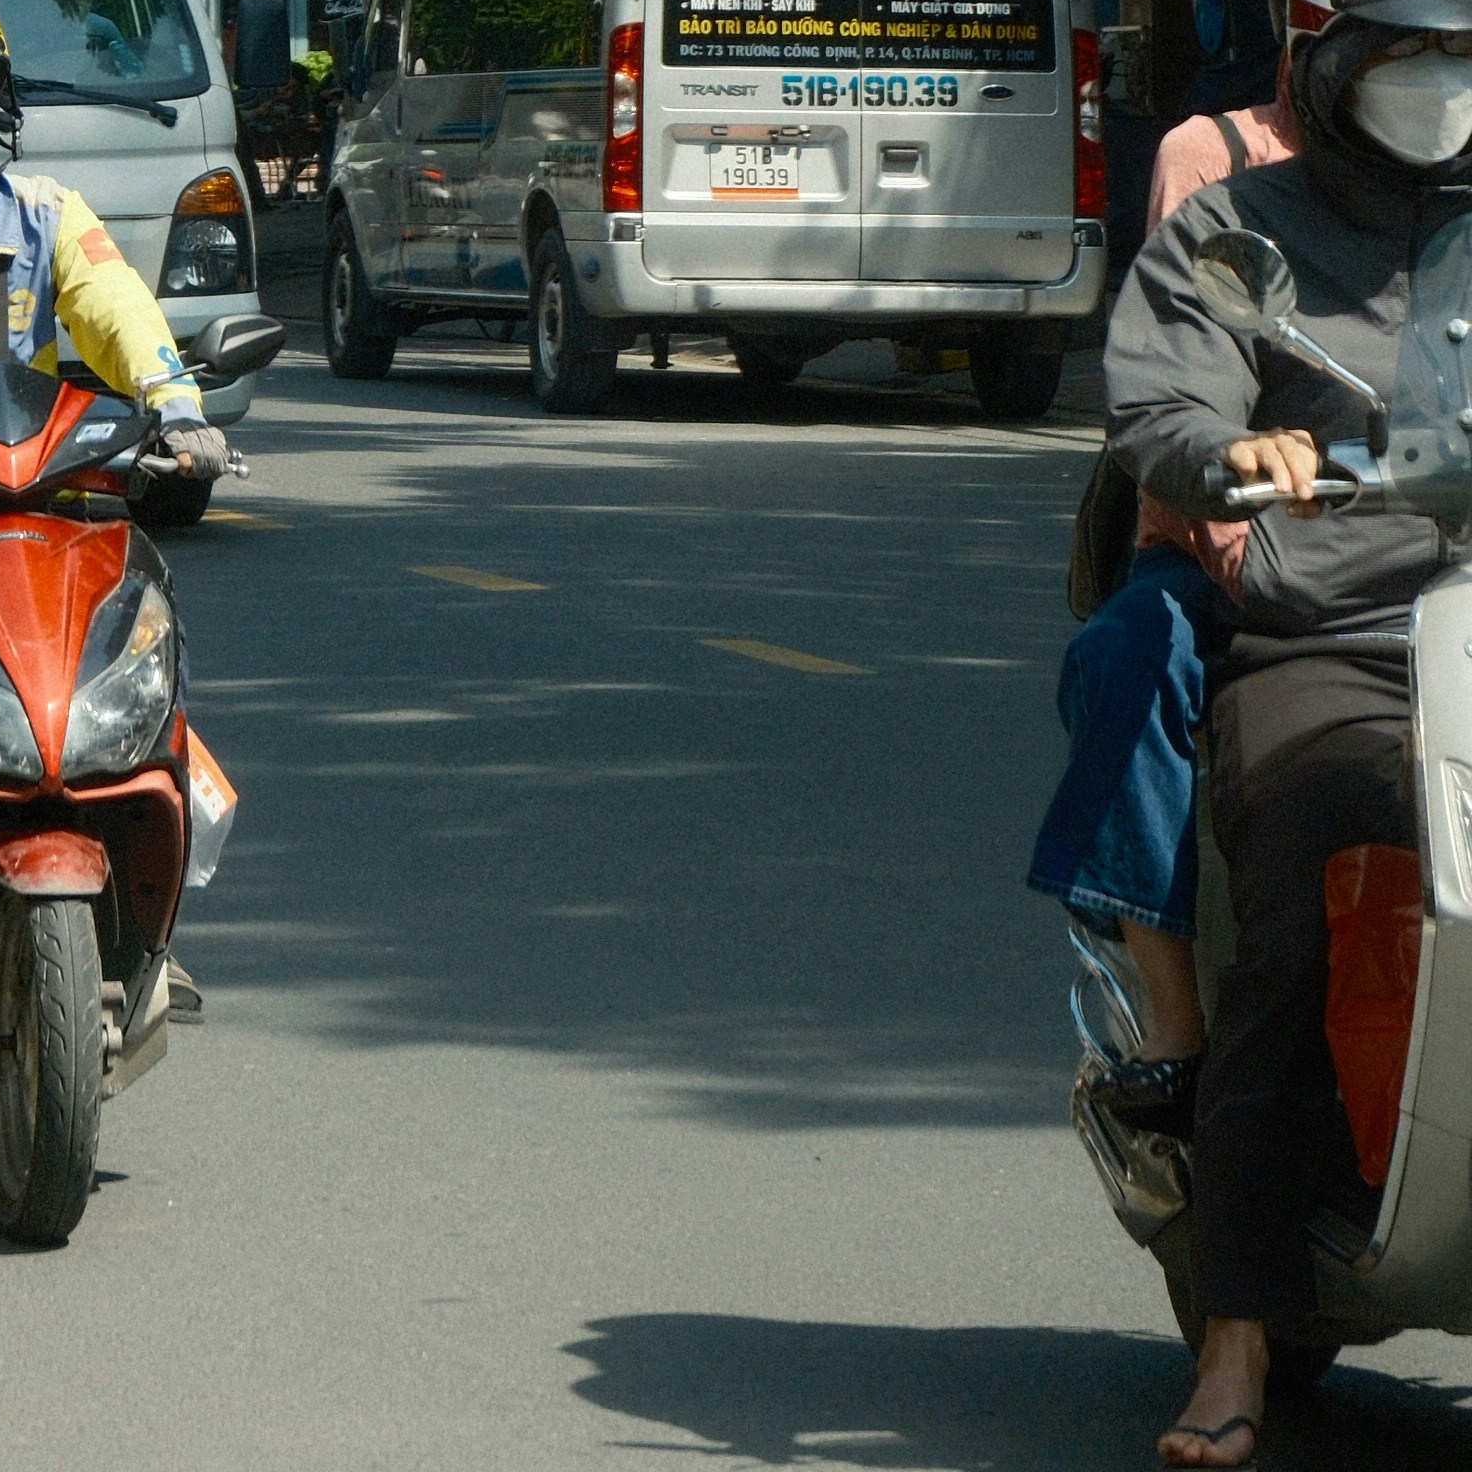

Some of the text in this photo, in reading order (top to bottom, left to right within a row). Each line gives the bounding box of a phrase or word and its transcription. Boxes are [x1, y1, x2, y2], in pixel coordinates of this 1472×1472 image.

[679, 14, 1039, 44] BẢO TRÌ BẢO DƯỠNG CÔNG NGHIỆP & DÂN DỤNG
[706, 44, 724, 57] 73
[783, 43, 820, 58] CÔNG
[679, 82, 760, 98] TRANSIT
[734, 146, 773, 165] 51B
[723, 167, 789, 187] 190.39
